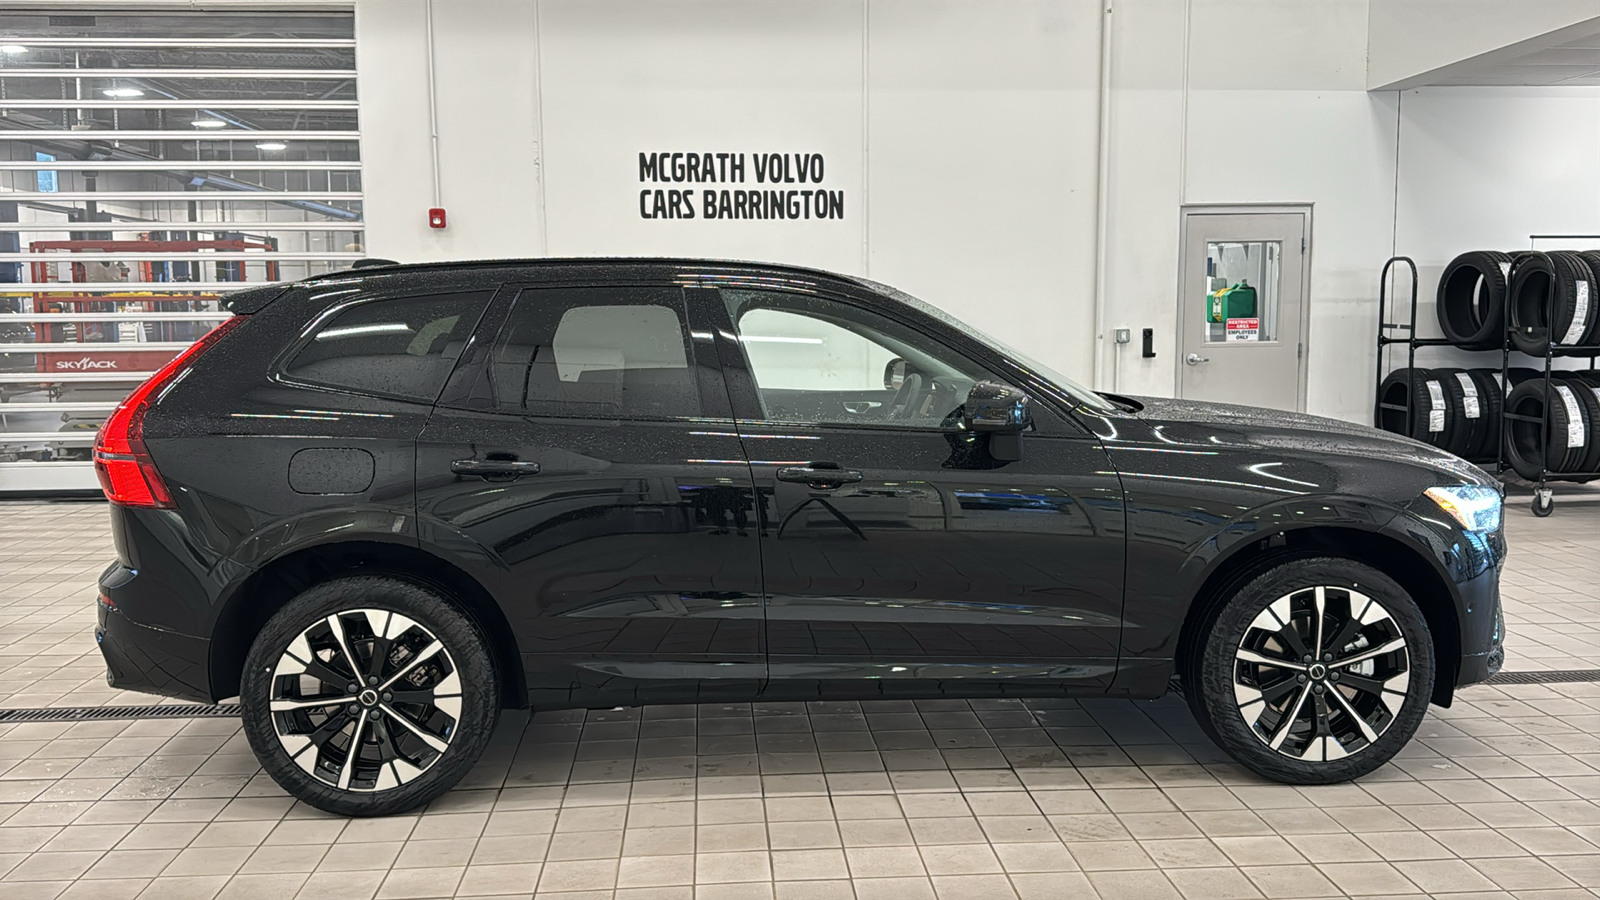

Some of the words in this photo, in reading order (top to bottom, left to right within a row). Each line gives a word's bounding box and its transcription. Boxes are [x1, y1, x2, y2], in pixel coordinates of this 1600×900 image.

[639, 152, 745, 183] MCGRATH
[753, 153, 825, 183] VOLVO
[640, 189, 695, 219] CARS
[703, 189, 844, 220] BARRINGTON
[56, 357, 118, 370] SKYJACK
